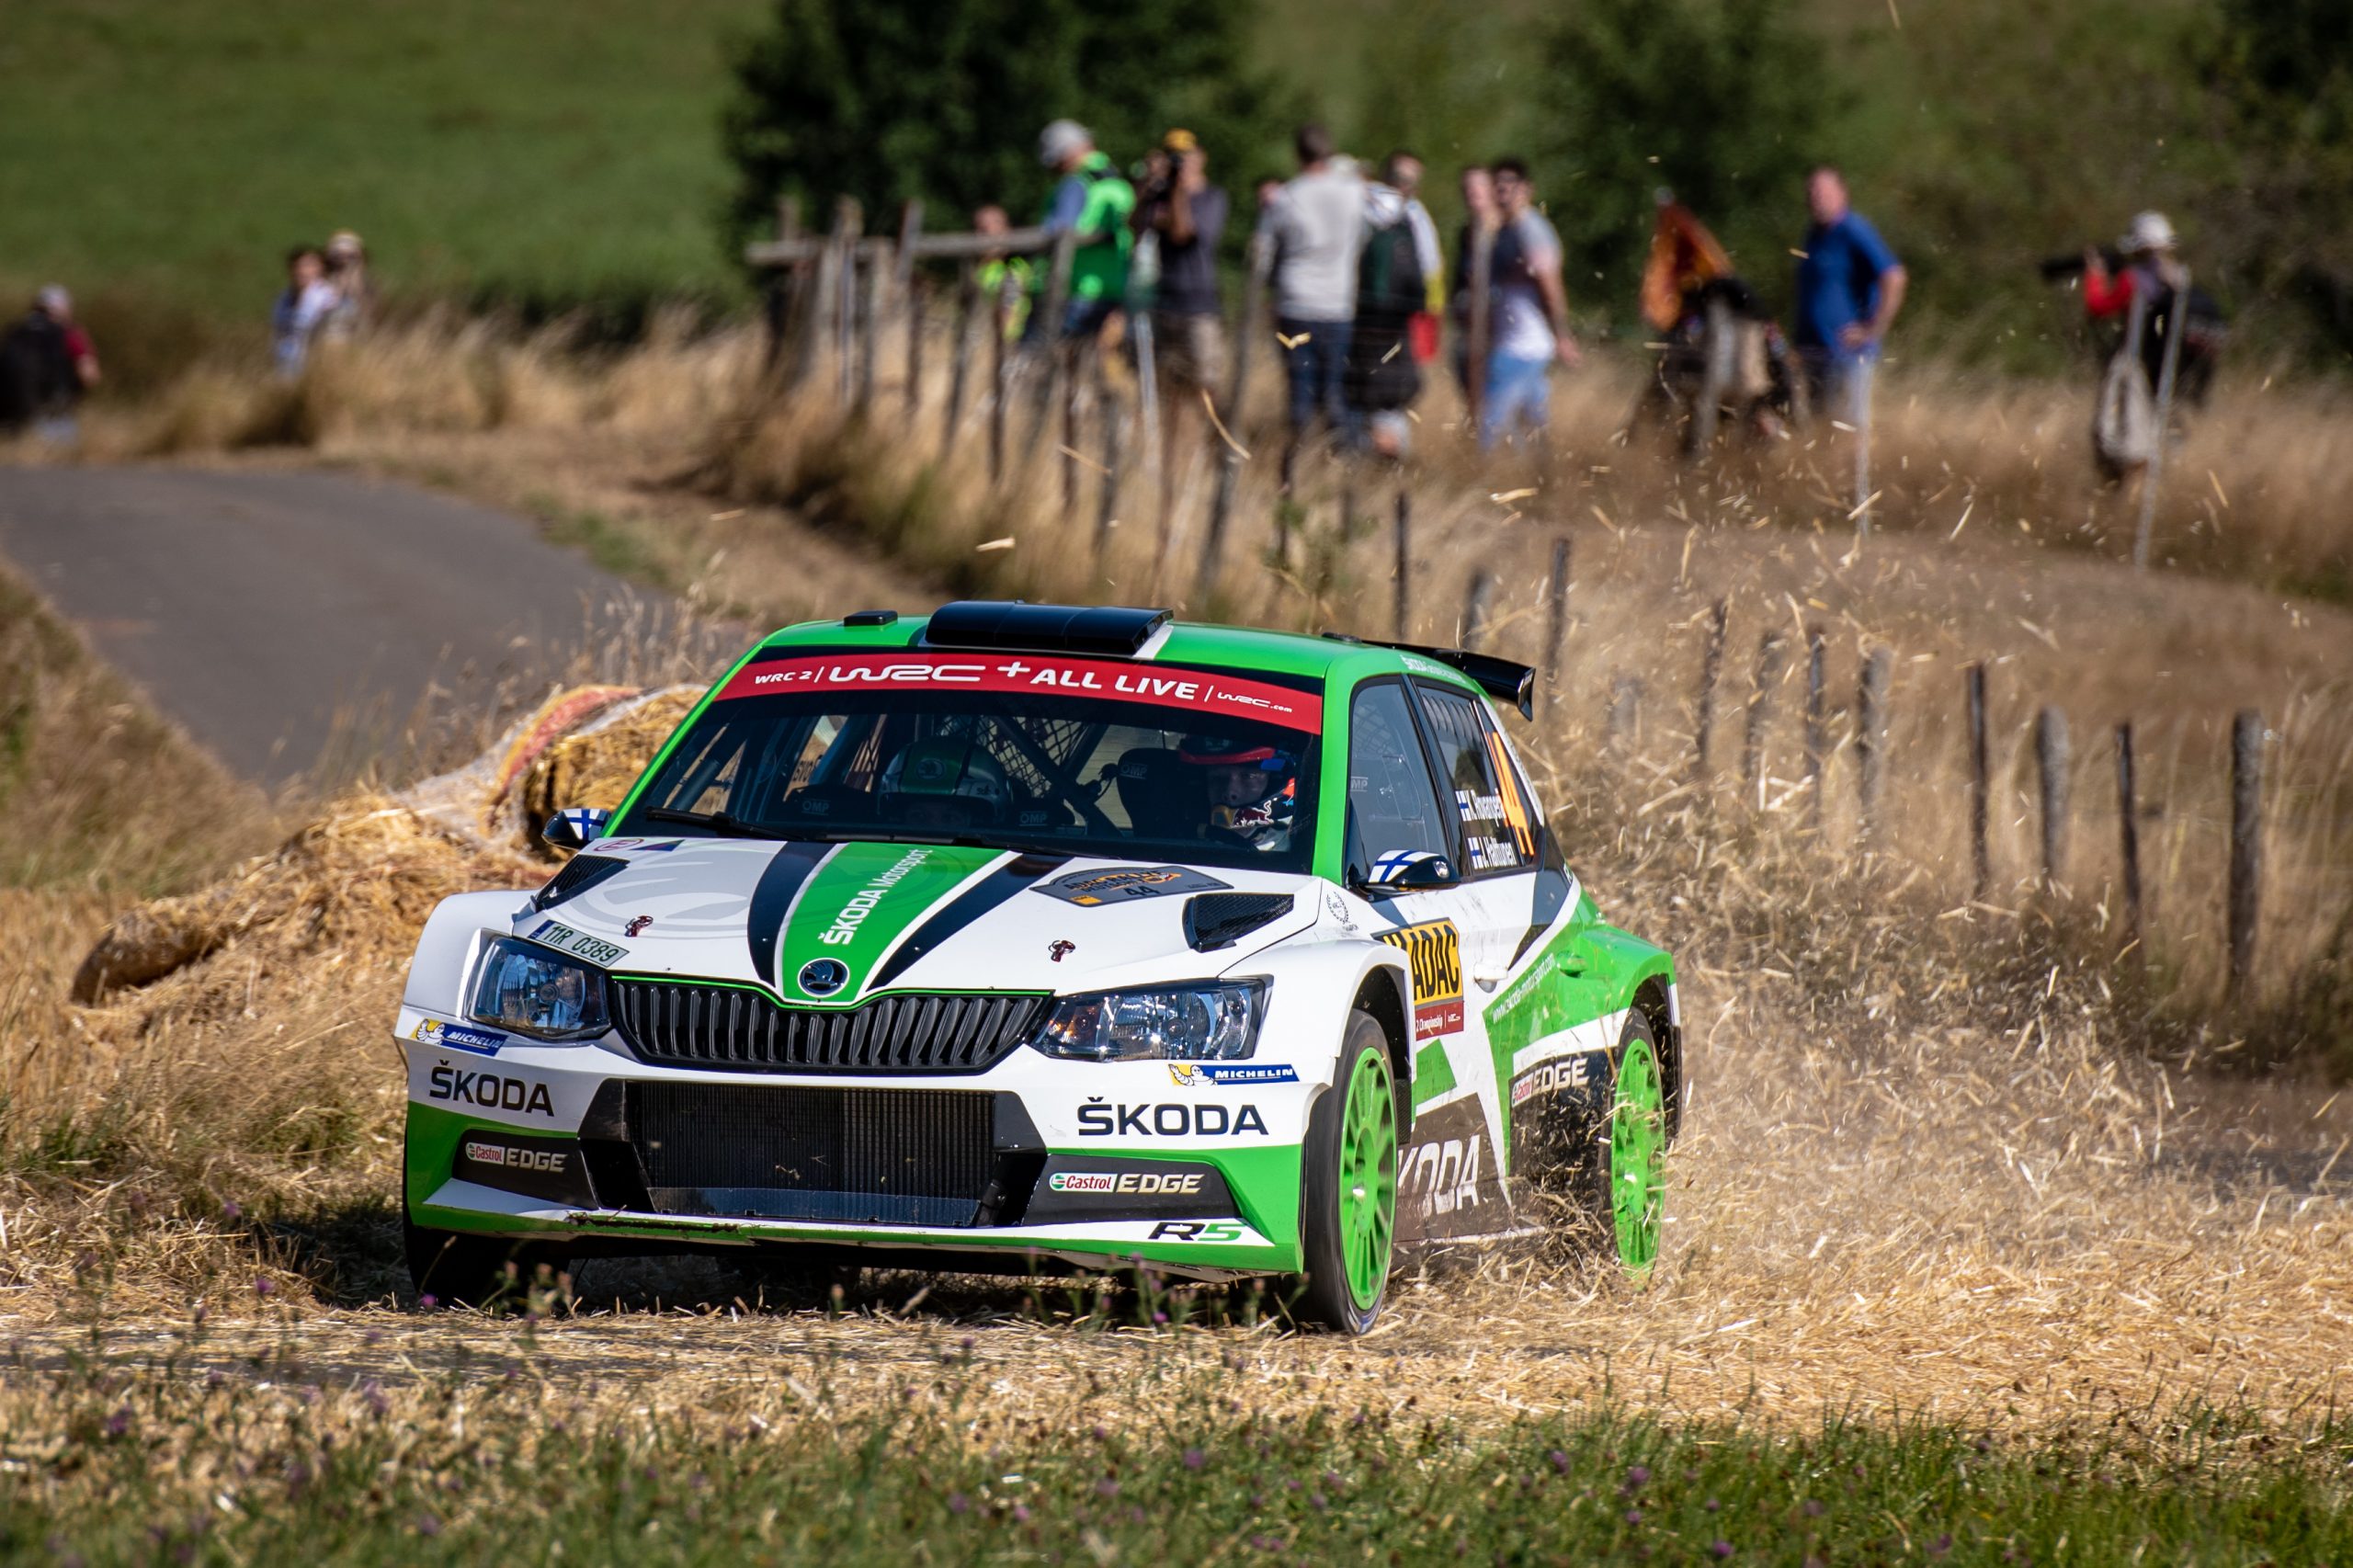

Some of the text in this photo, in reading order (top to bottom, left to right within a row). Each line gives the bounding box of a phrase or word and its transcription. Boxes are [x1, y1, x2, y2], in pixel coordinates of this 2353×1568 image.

[756, 671, 813, 685] WRC 2
[829, 665, 986, 682] WRC
[1029, 668, 1102, 689] ALL
[1114, 675, 1199, 700] LIVE
[1120, 764, 1148, 777] OMP
[1350, 778, 1368, 790] MP
[802, 801, 829, 813] OMP
[1019, 812, 1047, 824] OMP
[818, 848, 934, 945] ŠKODA Motorsport
[1123, 885, 1160, 896] 44
[543, 926, 620, 962] 11R 0389
[1409, 924, 1460, 1000] ADAC
[447, 1031, 505, 1049] MICHELIN
[1214, 1068, 1293, 1079] MICHELIN
[1532, 1057, 1590, 1095] EDGE
[429, 1060, 555, 1117] ŠKODA
[1077, 1096, 1269, 1136] ŠKODA
[475, 1145, 568, 1173] Castrol EDGE
[1065, 1173, 1205, 1193] Castrol EDGE
[1398, 1134, 1480, 1217] ODA
[1148, 1221, 1243, 1242] R5
